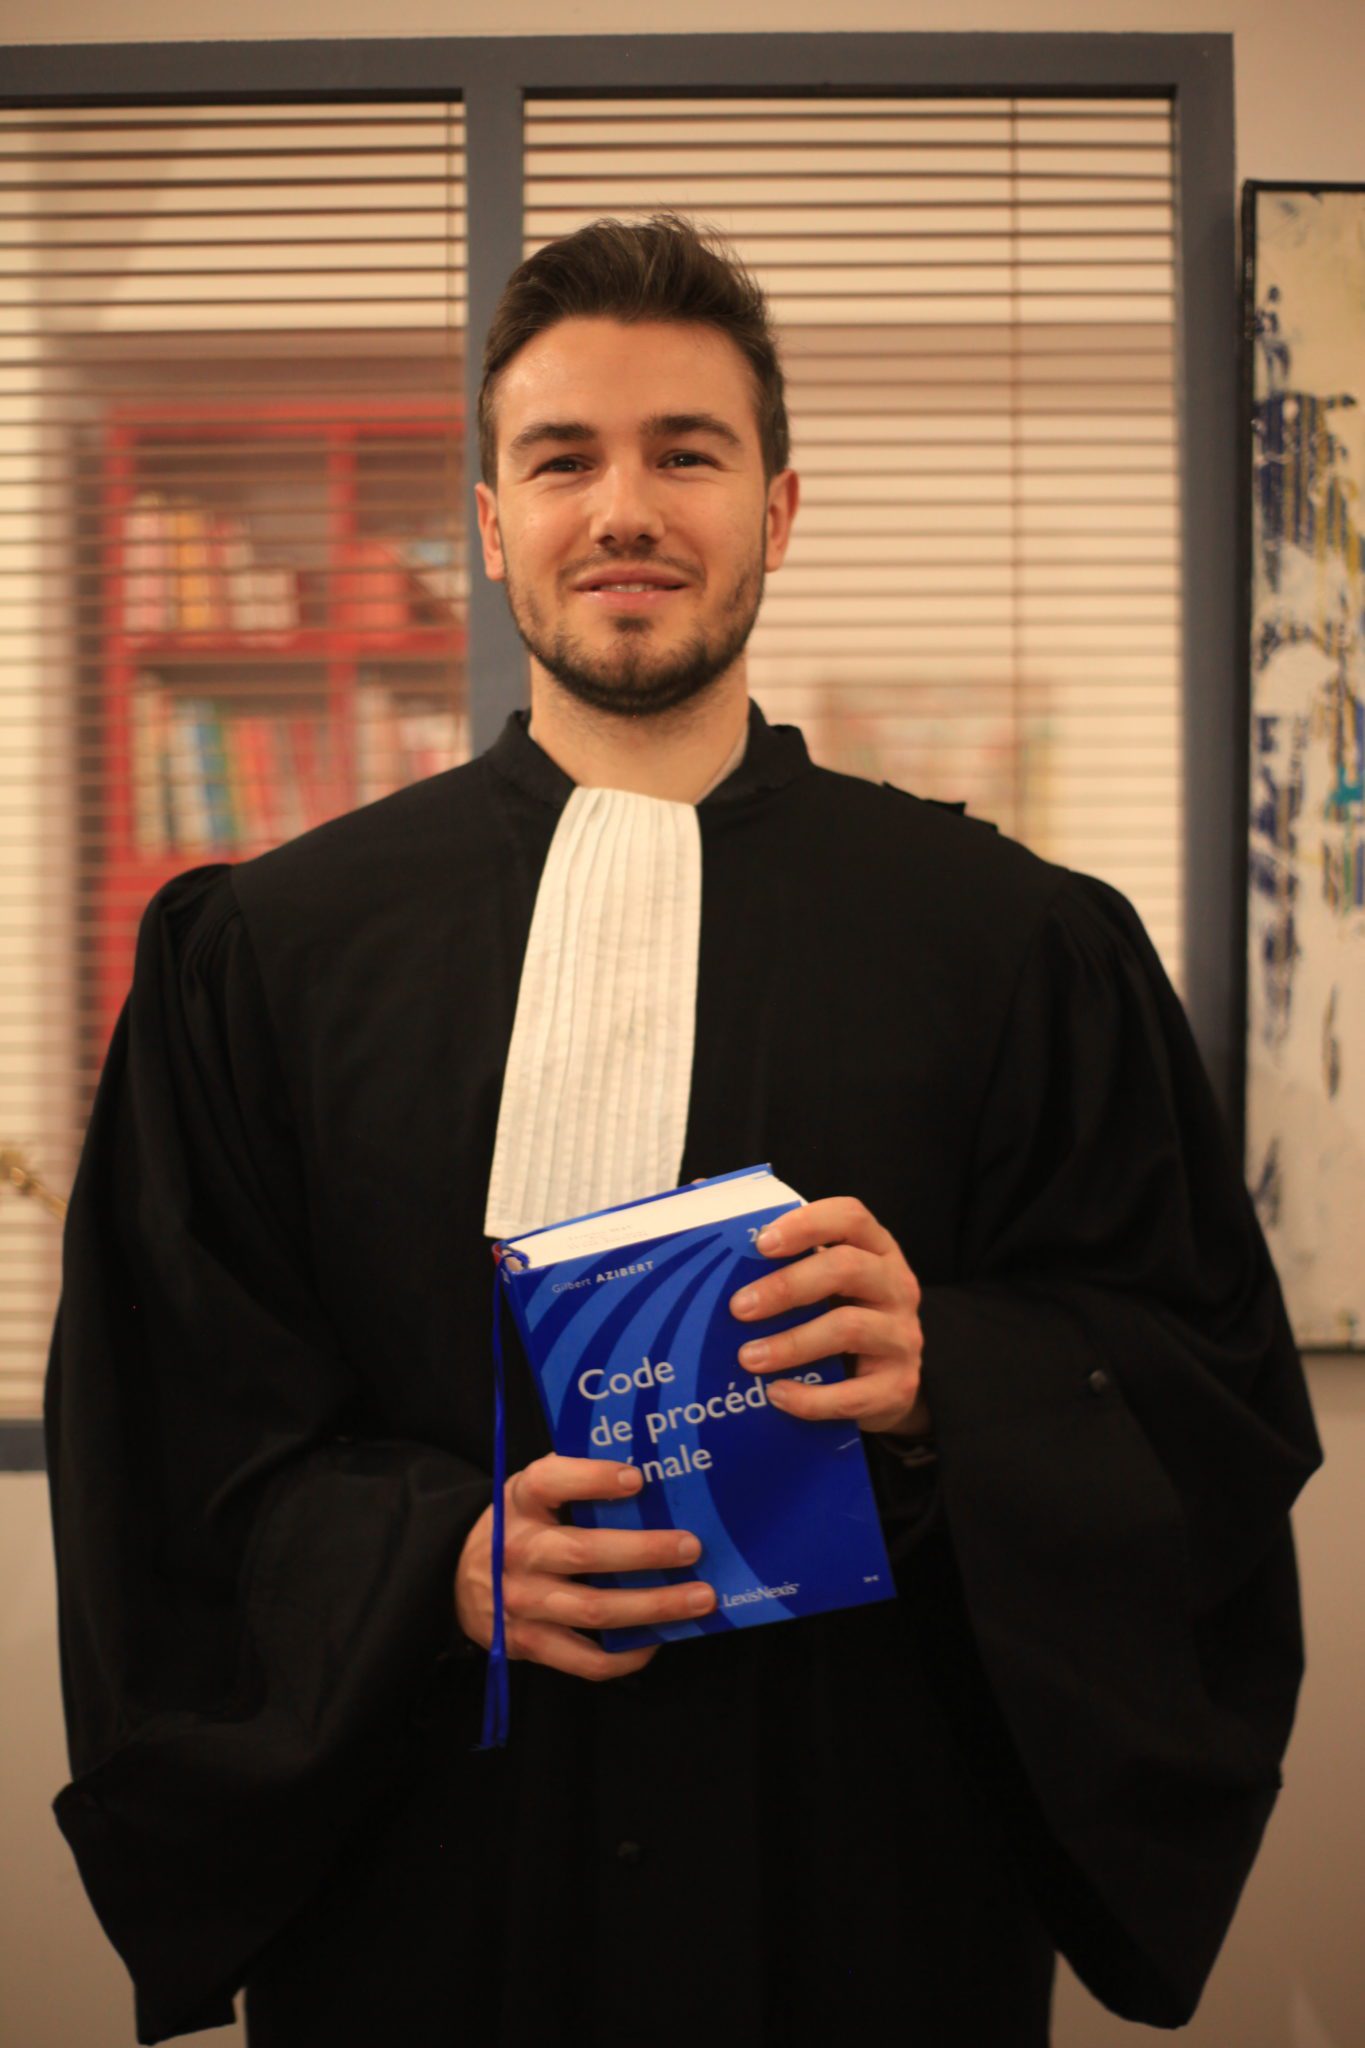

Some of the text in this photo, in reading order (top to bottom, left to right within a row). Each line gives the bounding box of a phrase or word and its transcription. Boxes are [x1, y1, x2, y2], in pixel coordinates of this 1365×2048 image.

[551, 1260, 654, 1293] Gilbert AZIBERT
[578, 1356, 676, 1401] Code
[590, 1371, 823, 1447] de procéde
[626, 1444, 713, 1482] nale
